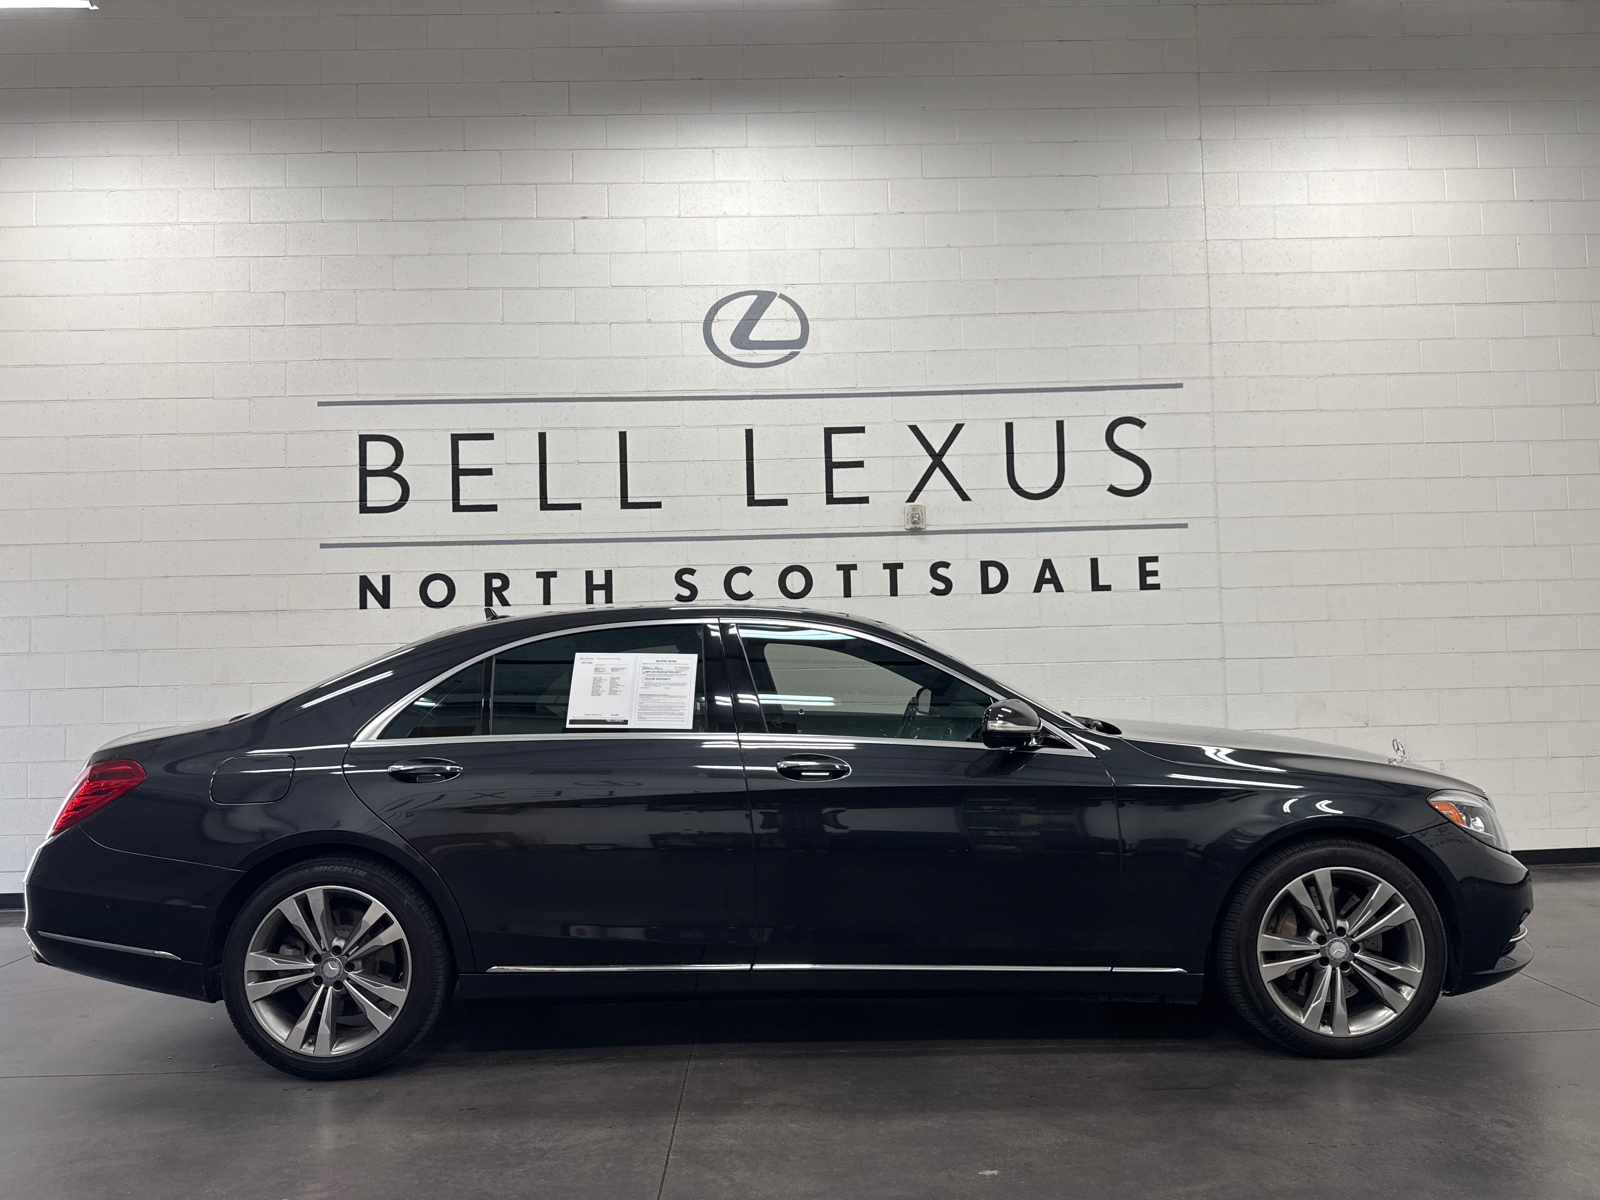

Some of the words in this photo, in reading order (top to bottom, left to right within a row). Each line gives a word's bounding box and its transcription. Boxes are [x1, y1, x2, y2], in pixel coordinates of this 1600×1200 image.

[358, 429, 662, 515] BELL
[745, 415, 1152, 506] LEXUS
[359, 568, 614, 610] NORTH
[674, 555, 1163, 603] SCOTTSDALE
[312, 865, 368, 877] MICHELIN
